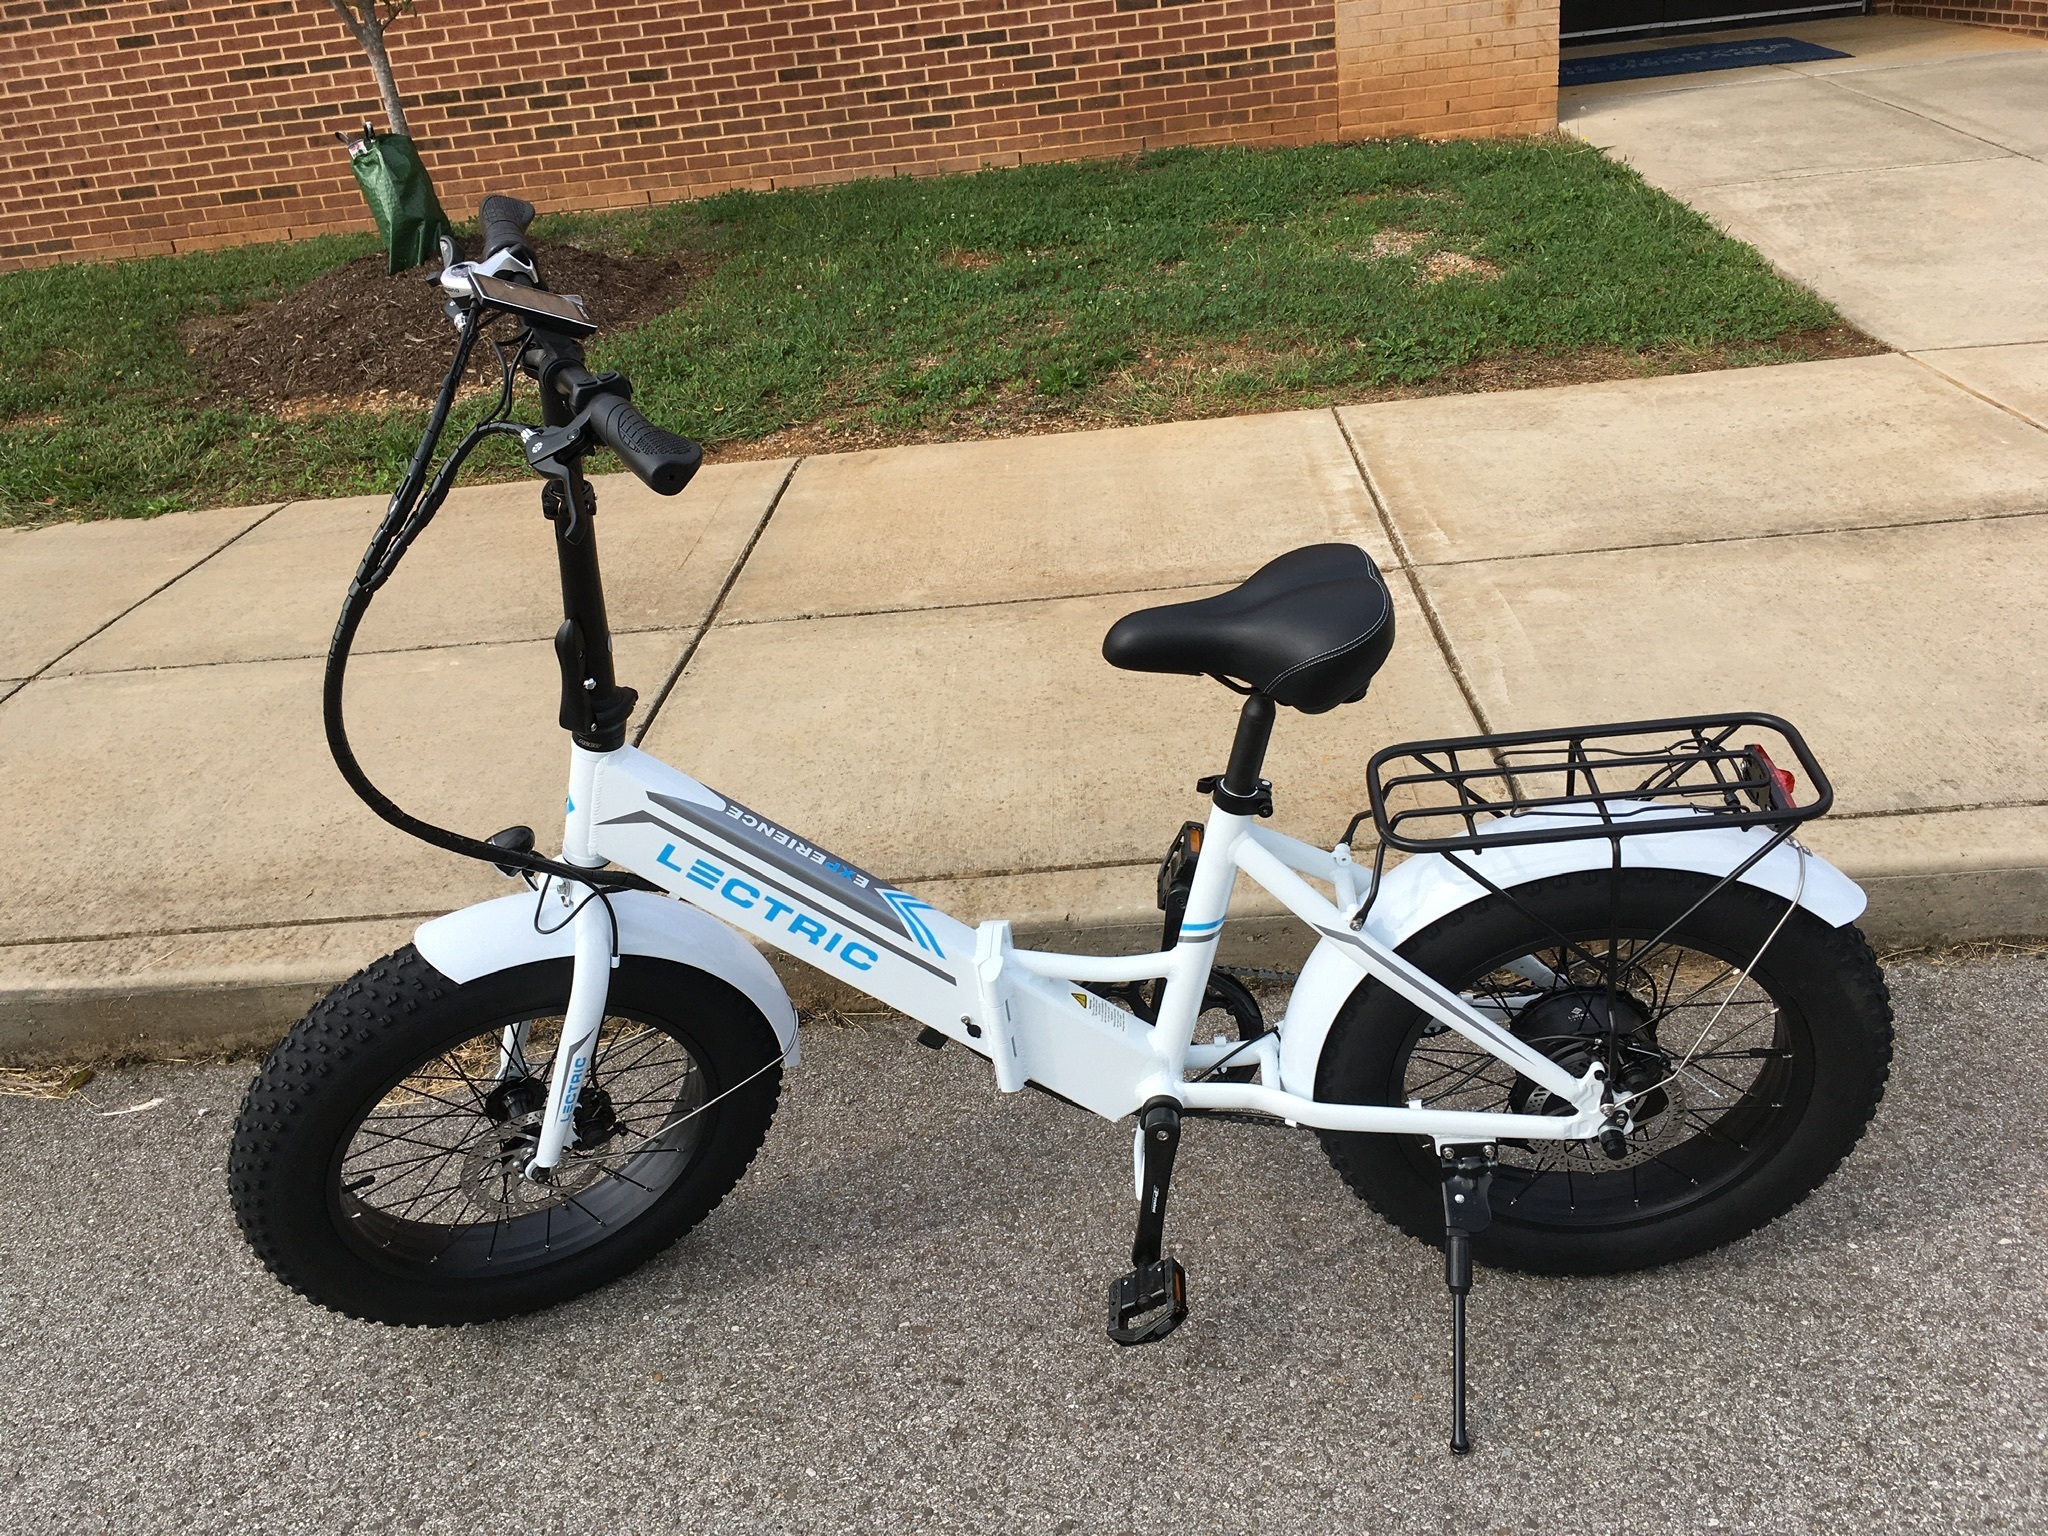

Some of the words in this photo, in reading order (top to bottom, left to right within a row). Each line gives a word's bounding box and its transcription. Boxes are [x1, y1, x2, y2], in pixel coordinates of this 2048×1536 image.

[725, 805, 870, 889] EXPERIENCE
[656, 843, 879, 971] LECTRIC
[560, 1056, 587, 1123] LECTRIC
